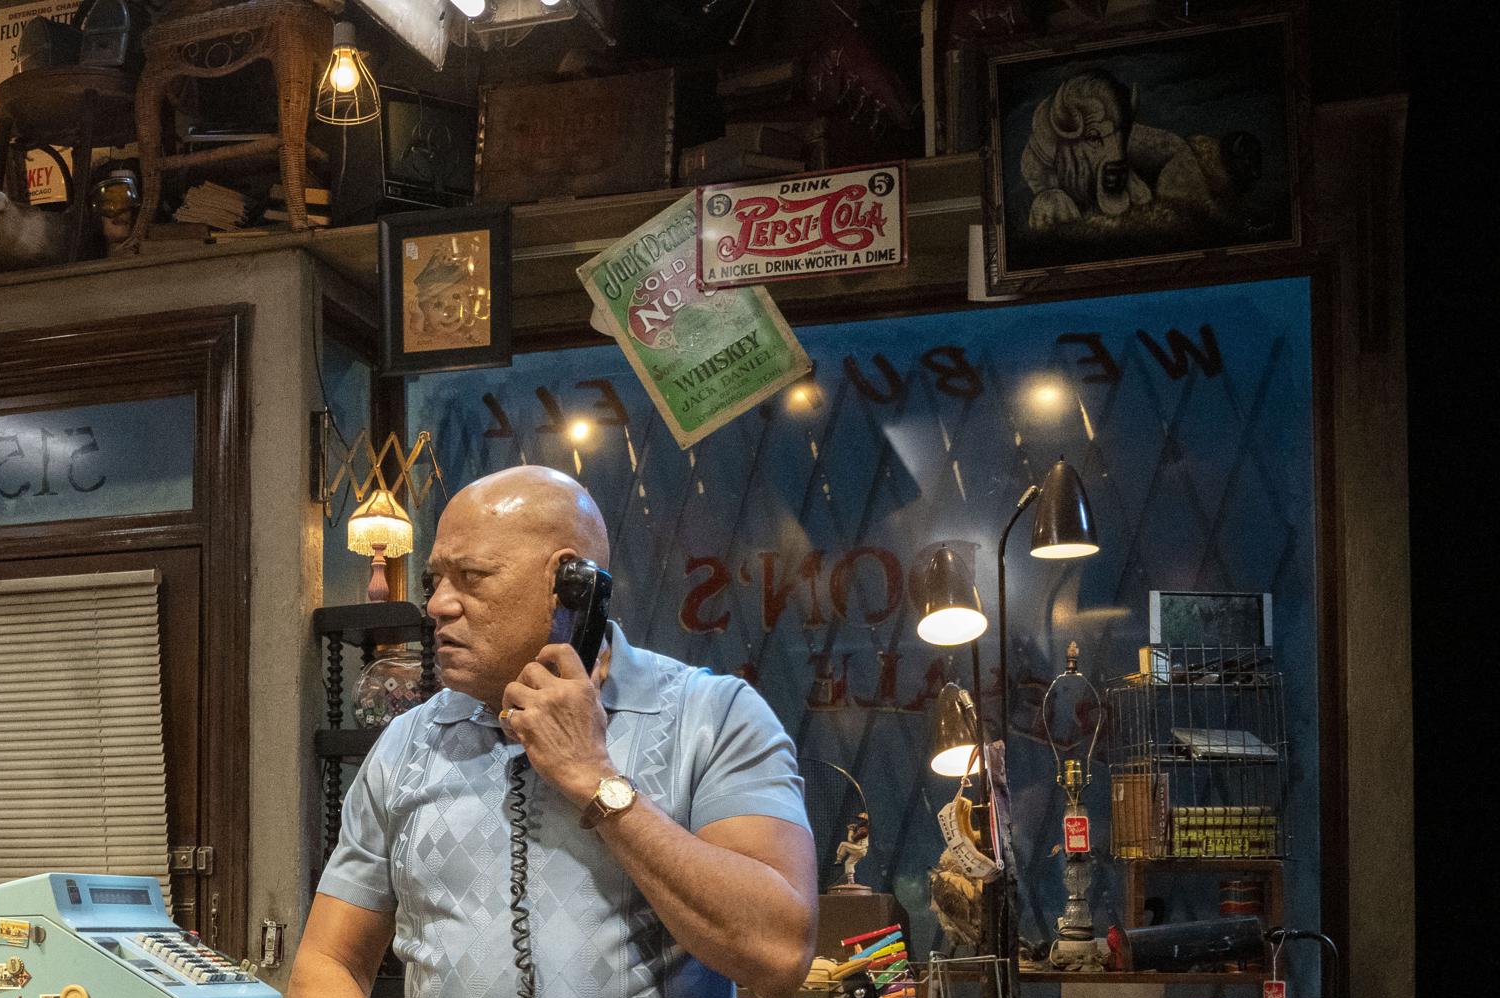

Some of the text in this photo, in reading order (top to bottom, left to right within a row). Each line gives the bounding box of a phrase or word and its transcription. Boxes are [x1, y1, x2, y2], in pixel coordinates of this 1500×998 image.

[8, 4, 53, 20] DEFENDING
[0, 20, 28, 41] FLOY
[779, 178, 833, 195] DRINK
[645, 258, 687, 291] OLD
[708, 248, 897, 280] A NICKEL DRINK-WORTH A DIME
[672, 329, 760, 393] WHISKEY
